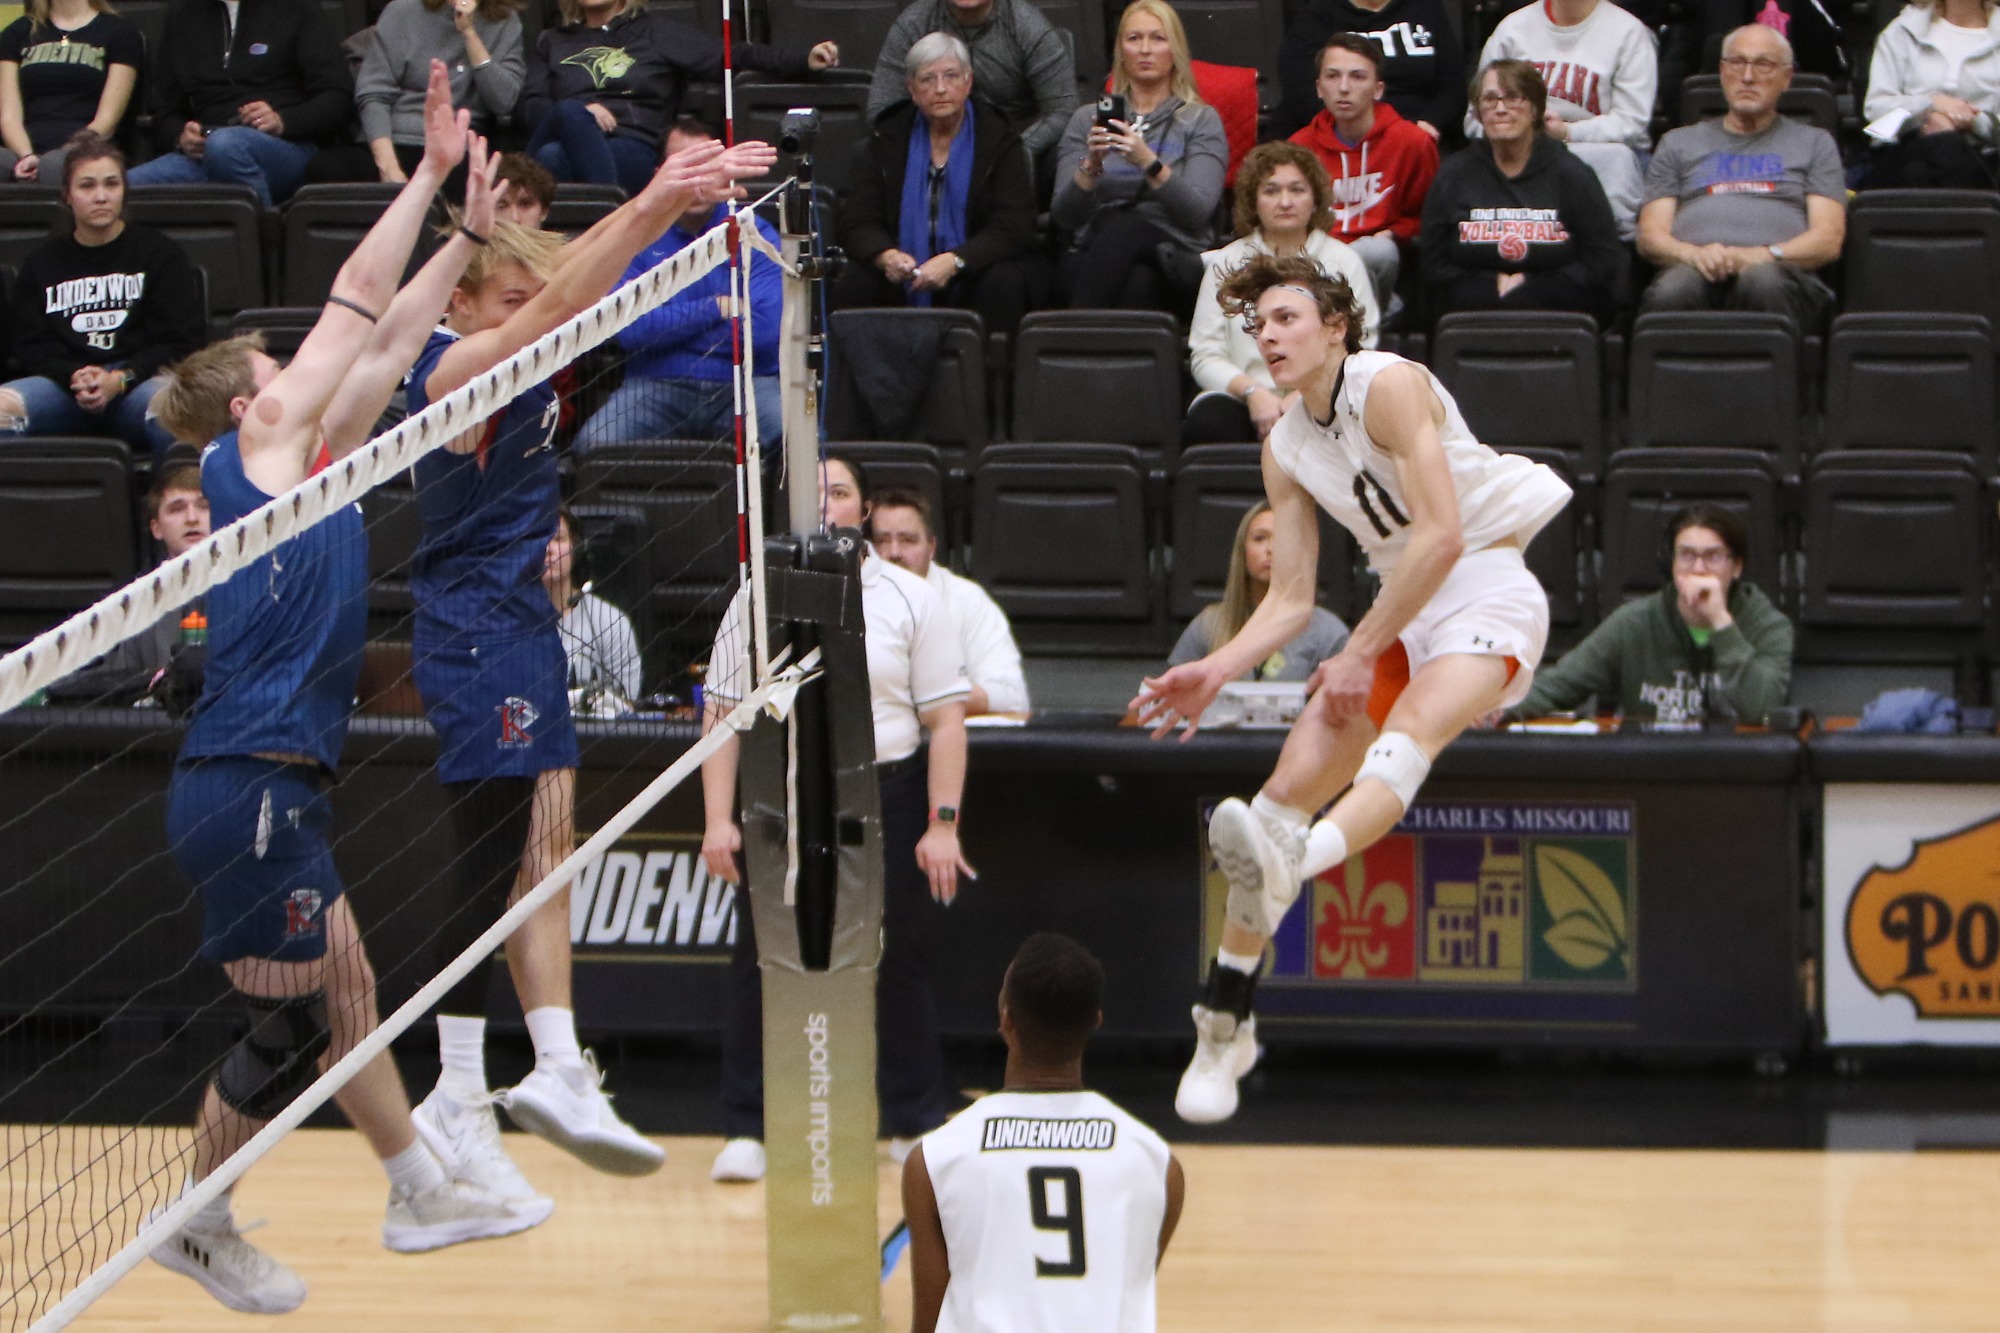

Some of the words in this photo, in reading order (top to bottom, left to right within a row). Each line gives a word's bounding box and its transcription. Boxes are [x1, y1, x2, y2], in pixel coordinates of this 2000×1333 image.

[1346, 22, 1434, 57] TL
[1533, 61, 1601, 116] IANA
[1459, 221, 1569, 242] VOLLEYBALL
[1470, 209, 1495, 220] KING
[86, 315, 116, 327] DAD
[1353, 469, 1411, 539] 11
[1513, 809, 1630, 831] MISSOURI
[1940, 982, 2000, 1001] SAN
[803, 1012, 831, 1097] sports
[982, 1117, 1116, 1151] LINDENWOOD
[805, 1102, 835, 1205] imports
[1027, 1166, 1086, 1277] 9
